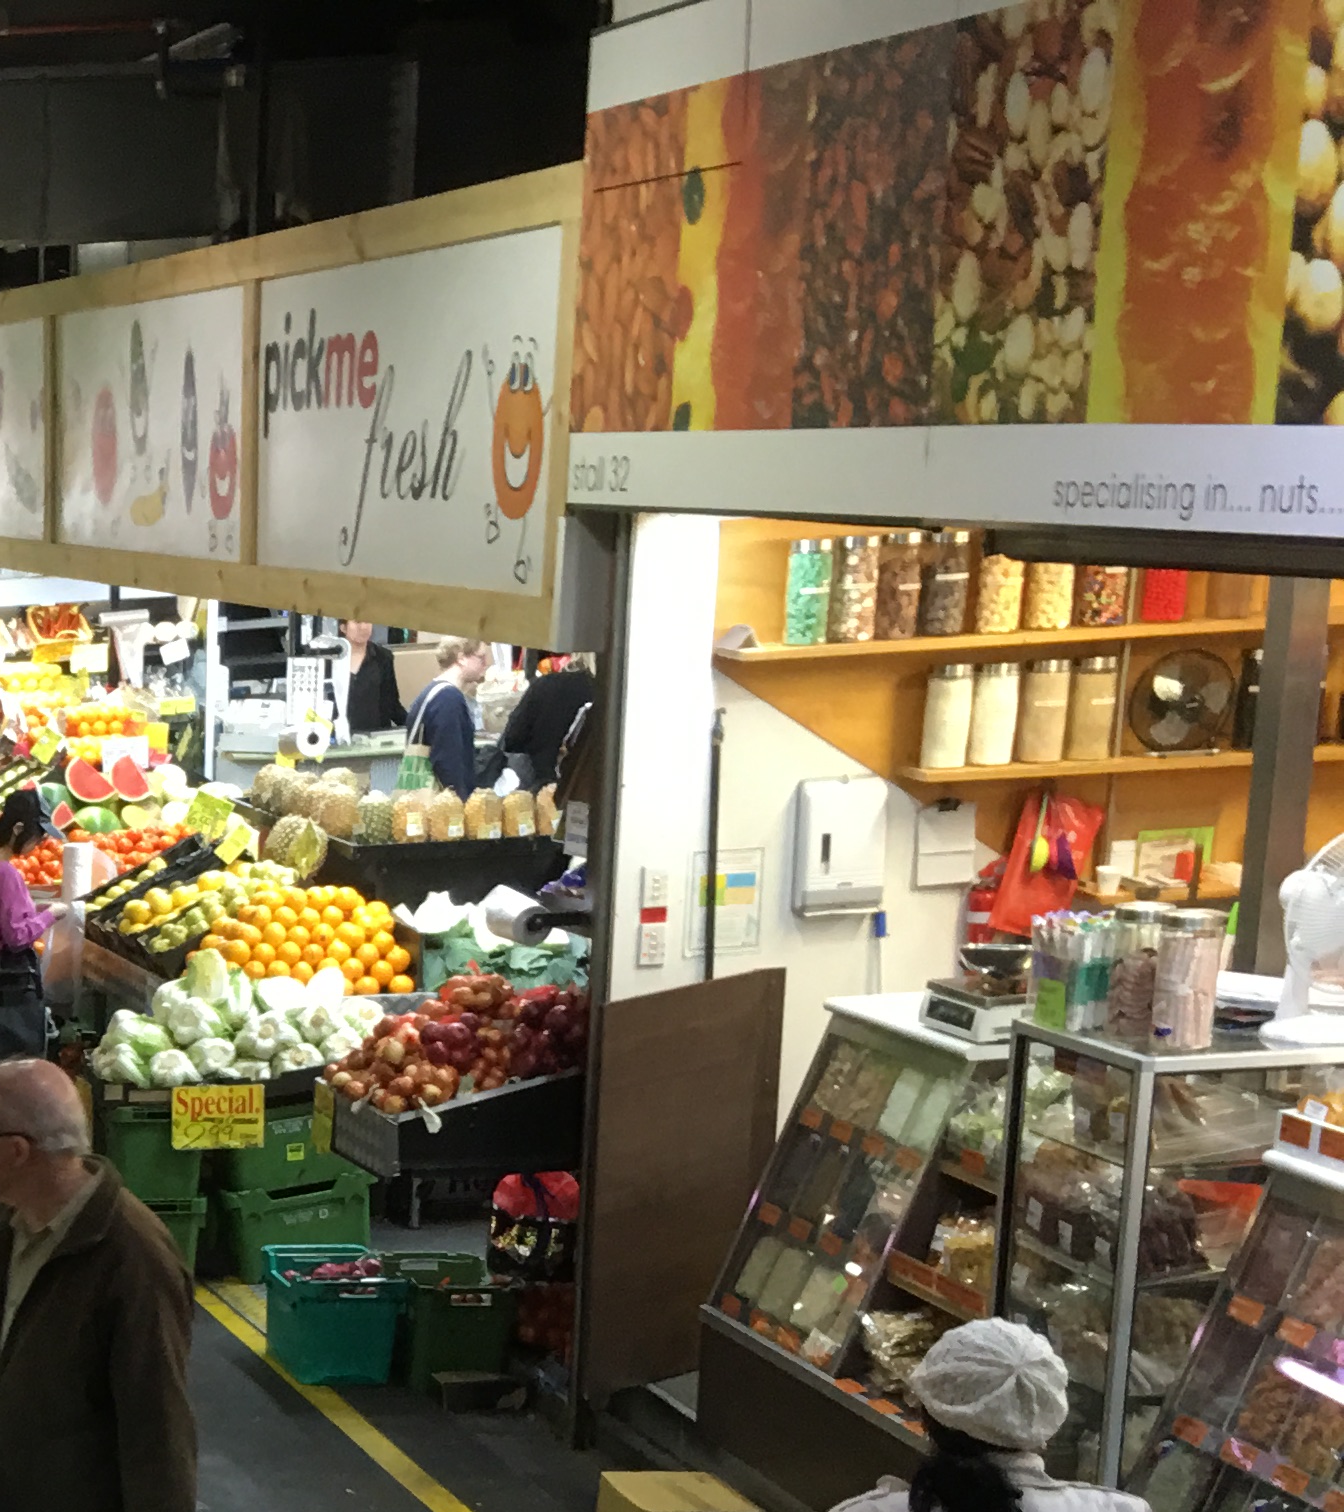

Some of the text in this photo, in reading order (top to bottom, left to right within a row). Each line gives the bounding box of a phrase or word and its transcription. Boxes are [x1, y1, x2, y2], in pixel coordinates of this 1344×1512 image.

[264, 308, 378, 439] pickme
[340, 349, 473, 567] fresh
[610, 455, 631, 492] 32
[1052, 473, 1195, 521] specialising
[175, 1087, 261, 1122] Special.
